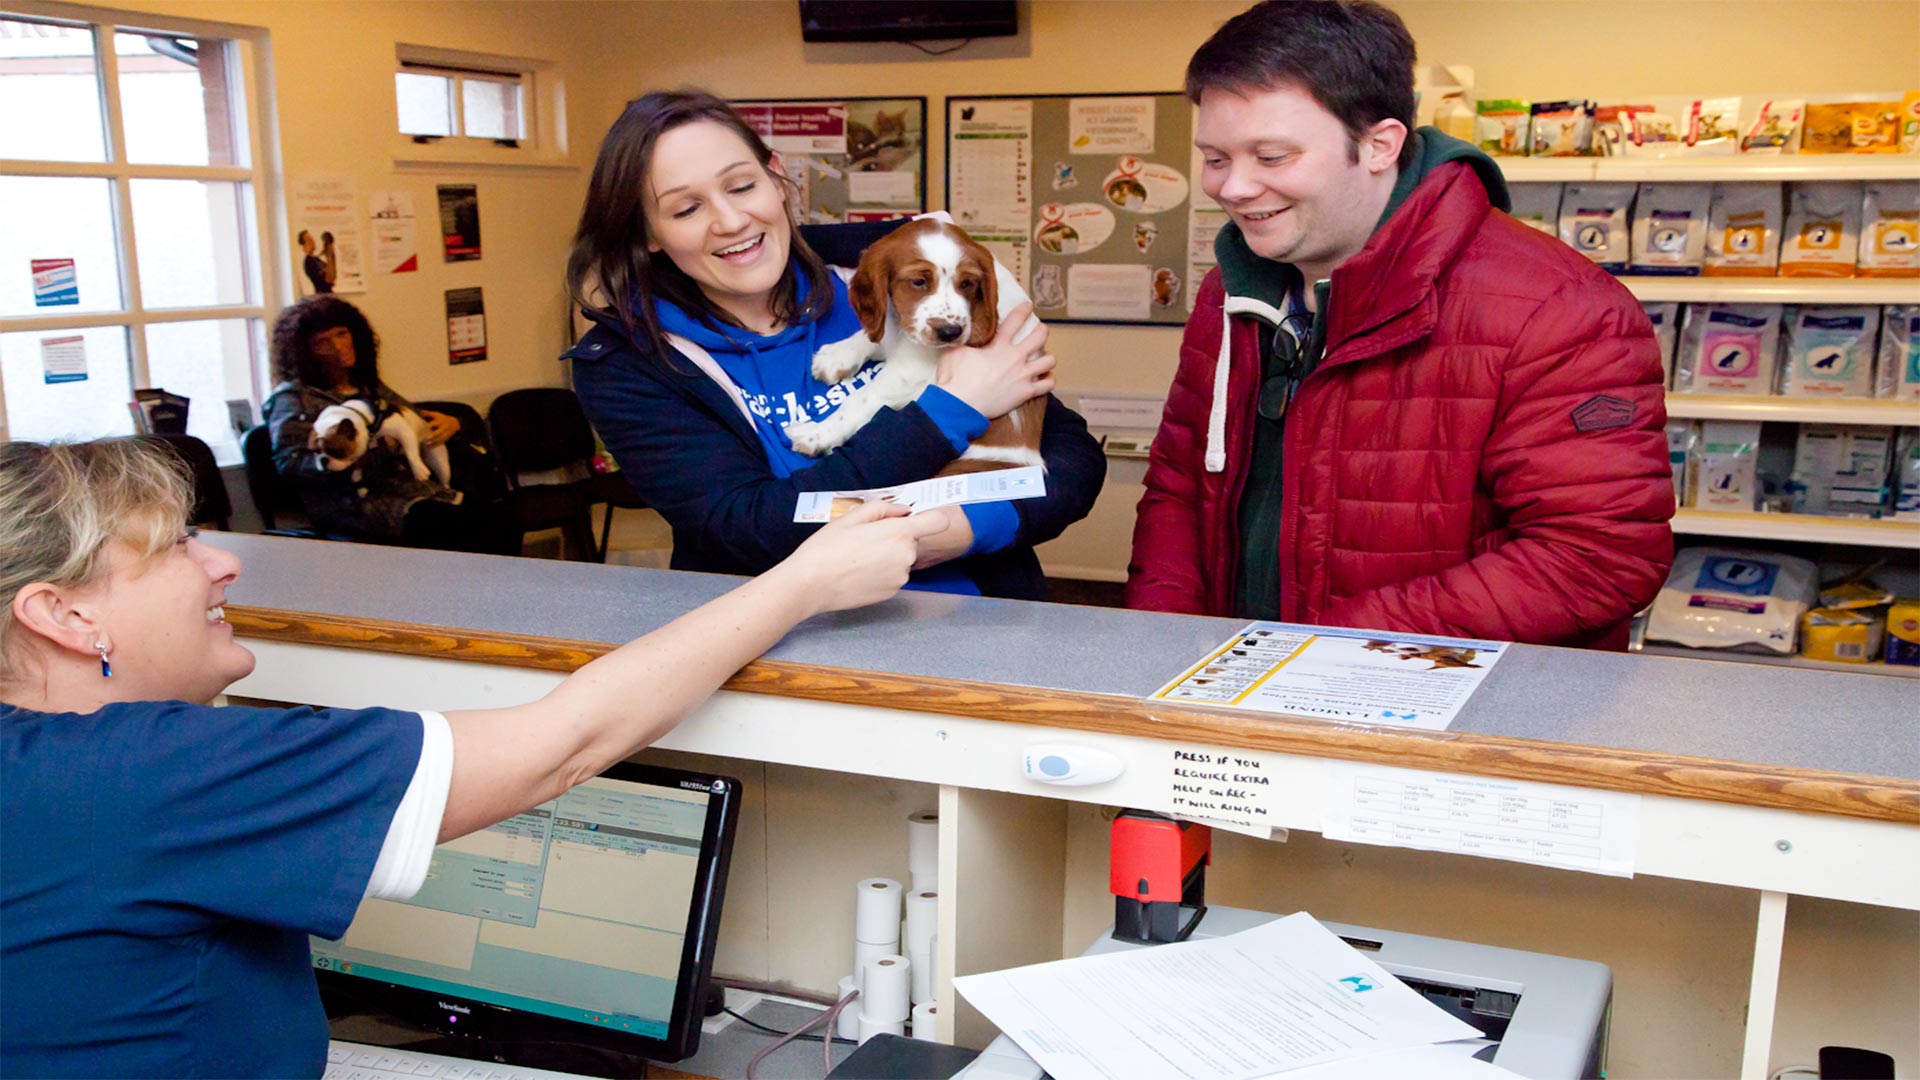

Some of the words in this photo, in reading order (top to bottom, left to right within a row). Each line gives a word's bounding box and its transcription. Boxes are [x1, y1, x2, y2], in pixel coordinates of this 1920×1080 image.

[1284, 704, 1370, 718] LAMOND
[1174, 751, 1211, 763] PRESS
[1217, 757, 1229, 765] IF
[1234, 758, 1261, 768] YOU
[1233, 774, 1270, 785] EXTRA
[1173, 784, 1203, 793] HELP
[1209, 789, 1223, 797] ON
[1189, 800, 1216, 809] WILL
[1221, 803, 1252, 814] RING
[1255, 807, 1267, 815] IN
